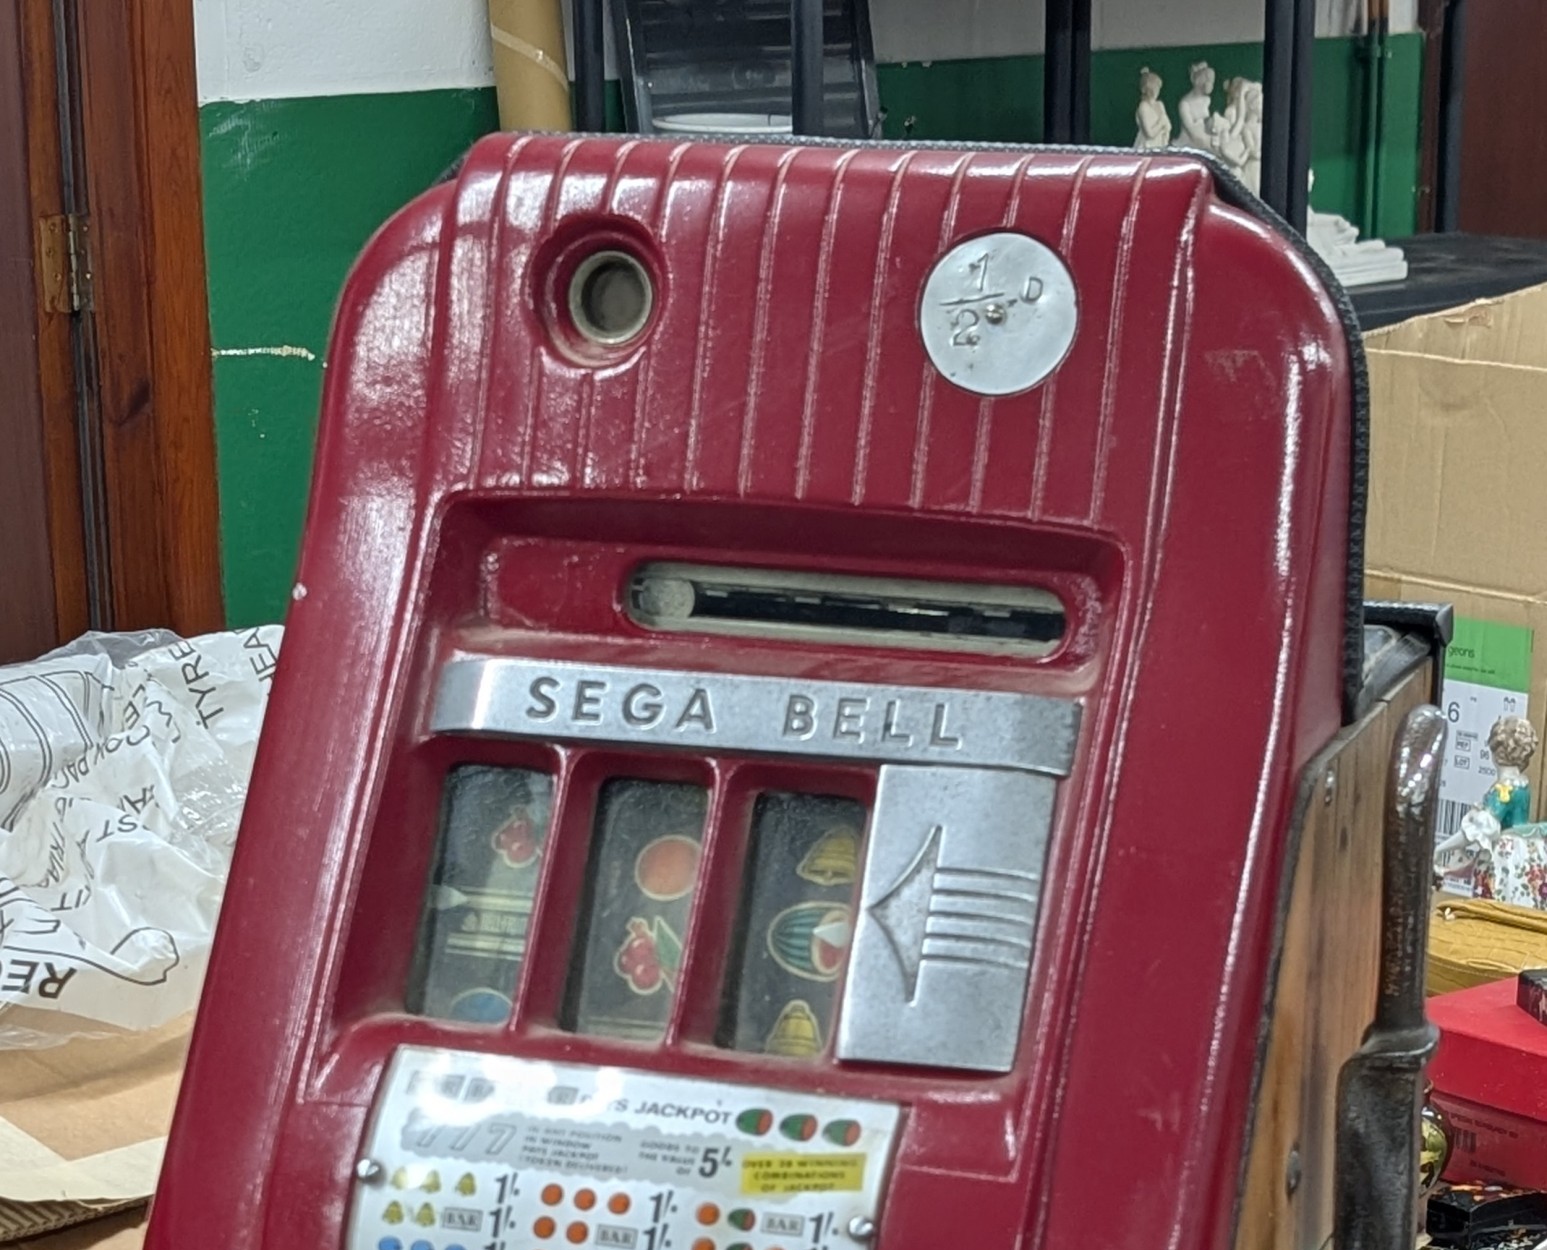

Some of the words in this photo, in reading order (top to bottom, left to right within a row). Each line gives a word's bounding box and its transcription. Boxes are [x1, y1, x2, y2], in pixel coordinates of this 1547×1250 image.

[1448, 646, 1475, 658] geons
[169, 641, 224, 729] TYRE
[526, 676, 718, 734] SEGA
[781, 692, 963, 750] BELL
[1448, 701, 1460, 723] 6
[0, 958, 78, 1000] RE
[634, 1101, 732, 1125] JACKPOT
